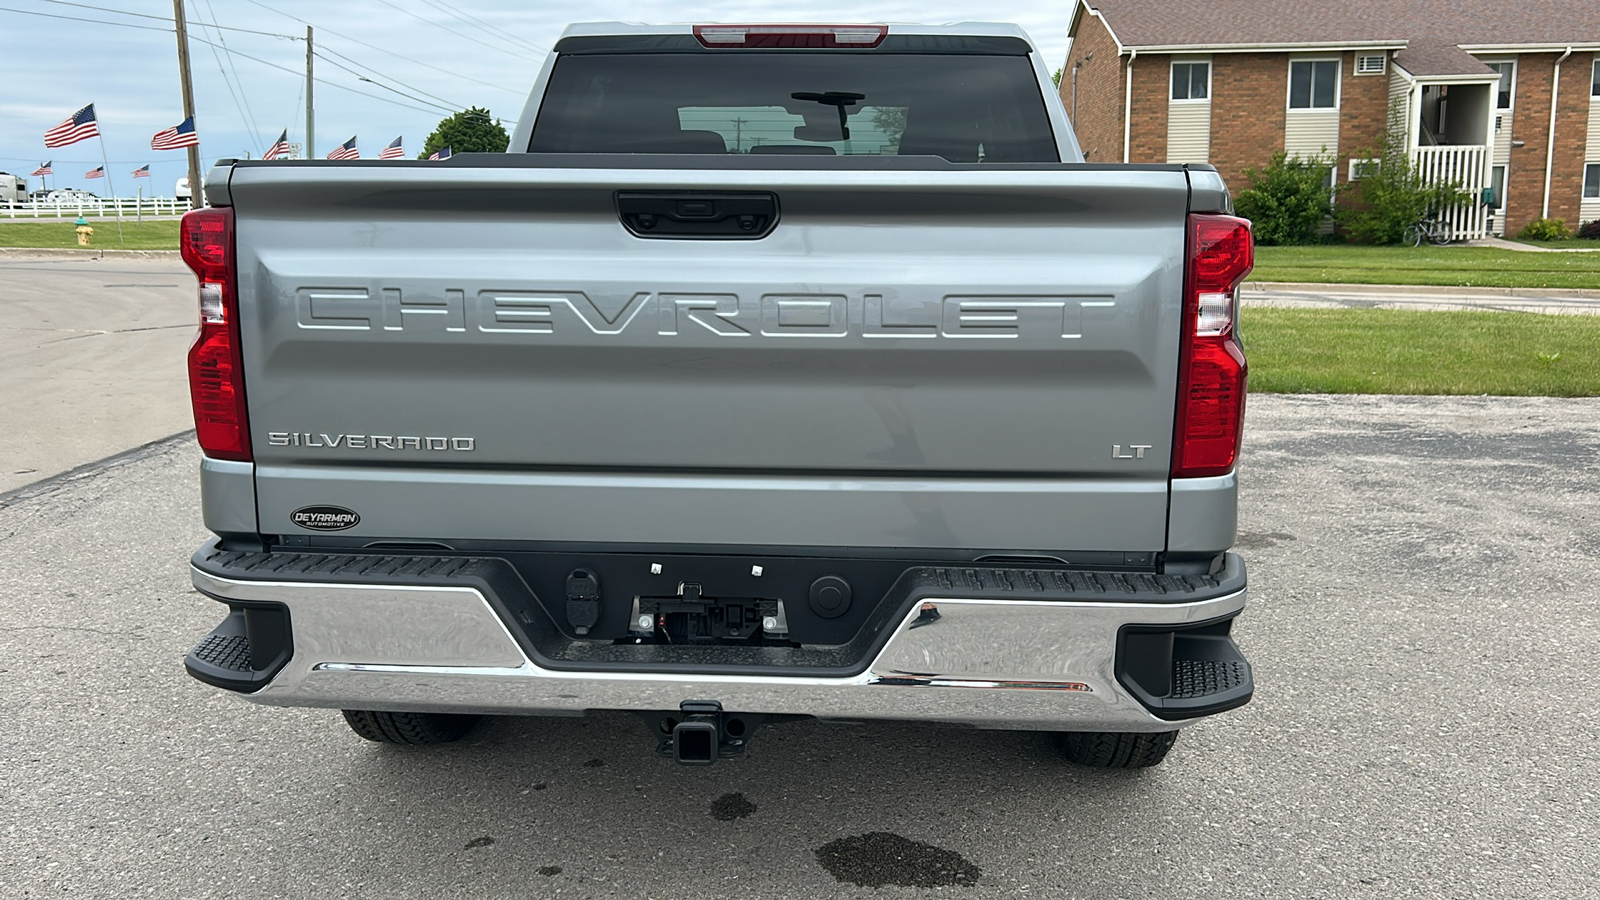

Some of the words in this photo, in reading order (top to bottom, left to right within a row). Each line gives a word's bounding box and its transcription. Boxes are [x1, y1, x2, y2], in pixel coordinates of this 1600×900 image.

[295, 286, 1115, 338] CHEVROLET
[268, 432, 475, 452] SILVERADO
[1112, 444, 1152, 459] LT
[295, 512, 355, 522] DEYARMAN
